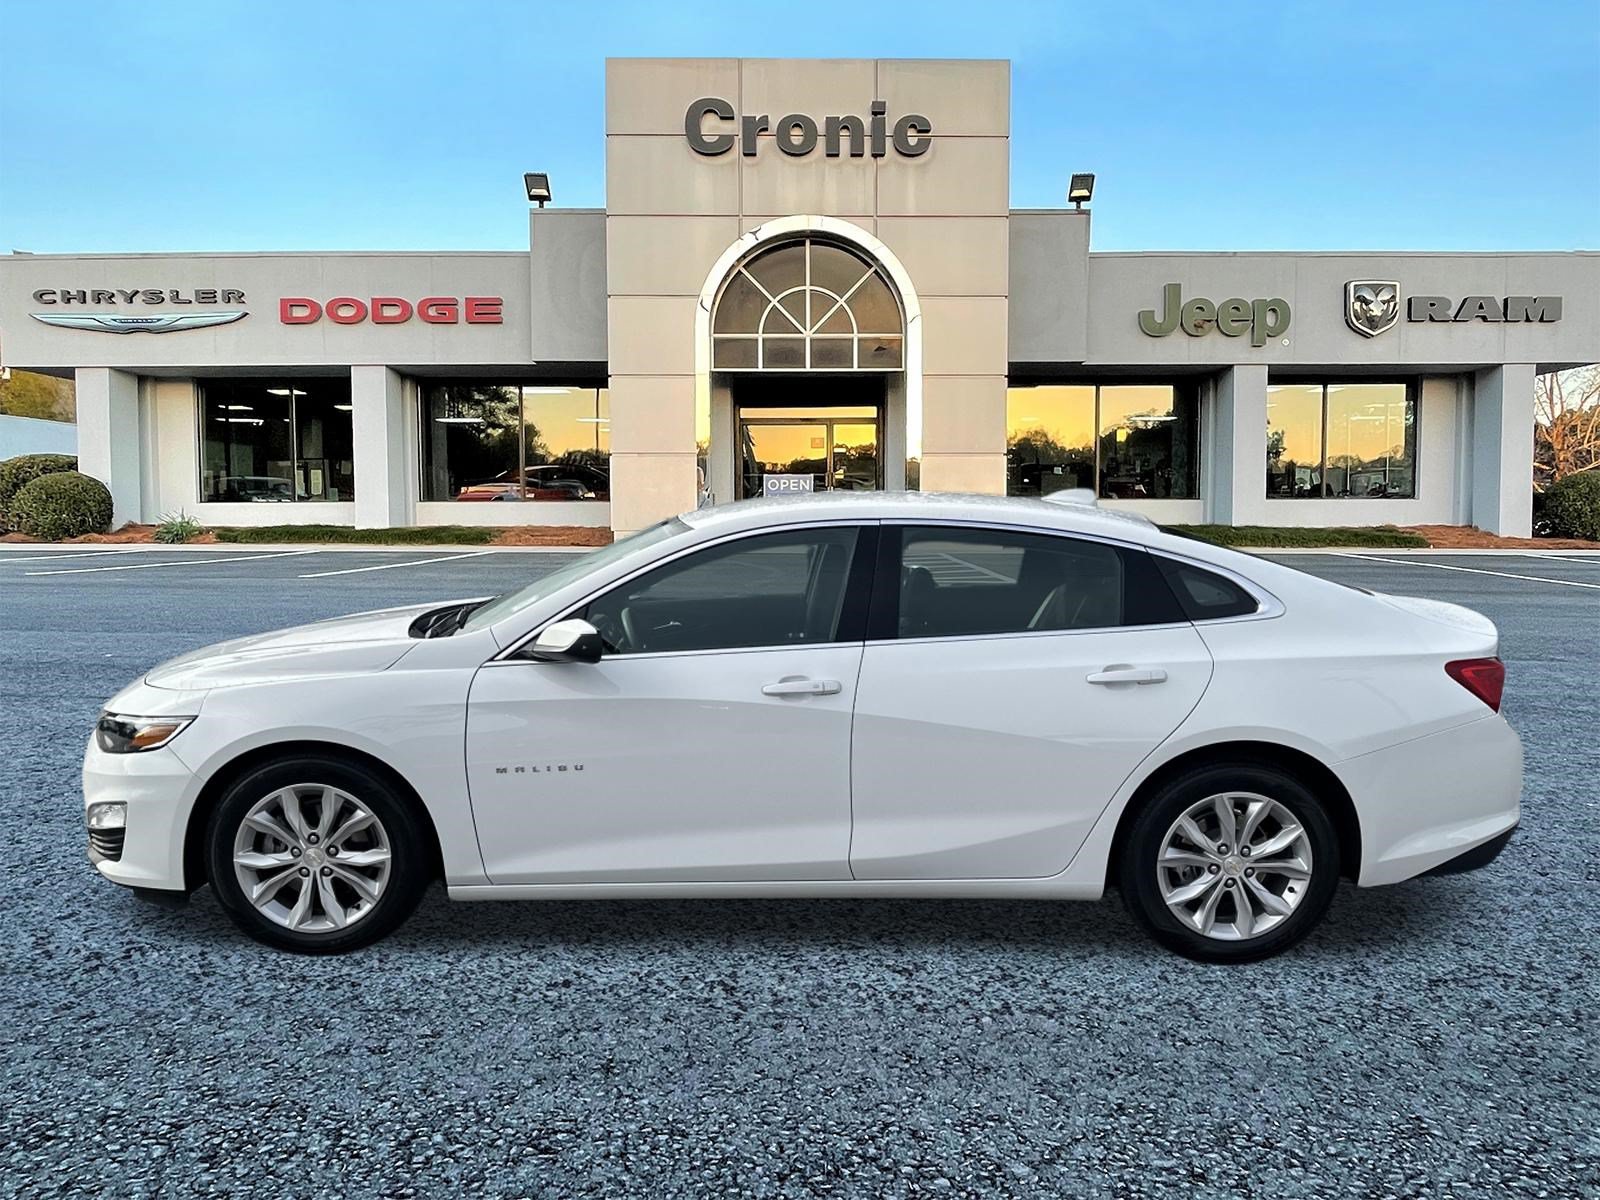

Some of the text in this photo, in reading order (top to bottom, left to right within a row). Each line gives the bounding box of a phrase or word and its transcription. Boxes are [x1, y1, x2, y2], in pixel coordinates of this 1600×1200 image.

[685, 97, 932, 157] Cronic
[32, 288, 246, 304] CHRYSLER
[1407, 296, 1562, 322] RAM
[279, 297, 504, 324] DODGE
[1138, 283, 1291, 347] Jeep
[768, 479, 810, 490] OPEN
[496, 764, 584, 774] MALIBU
